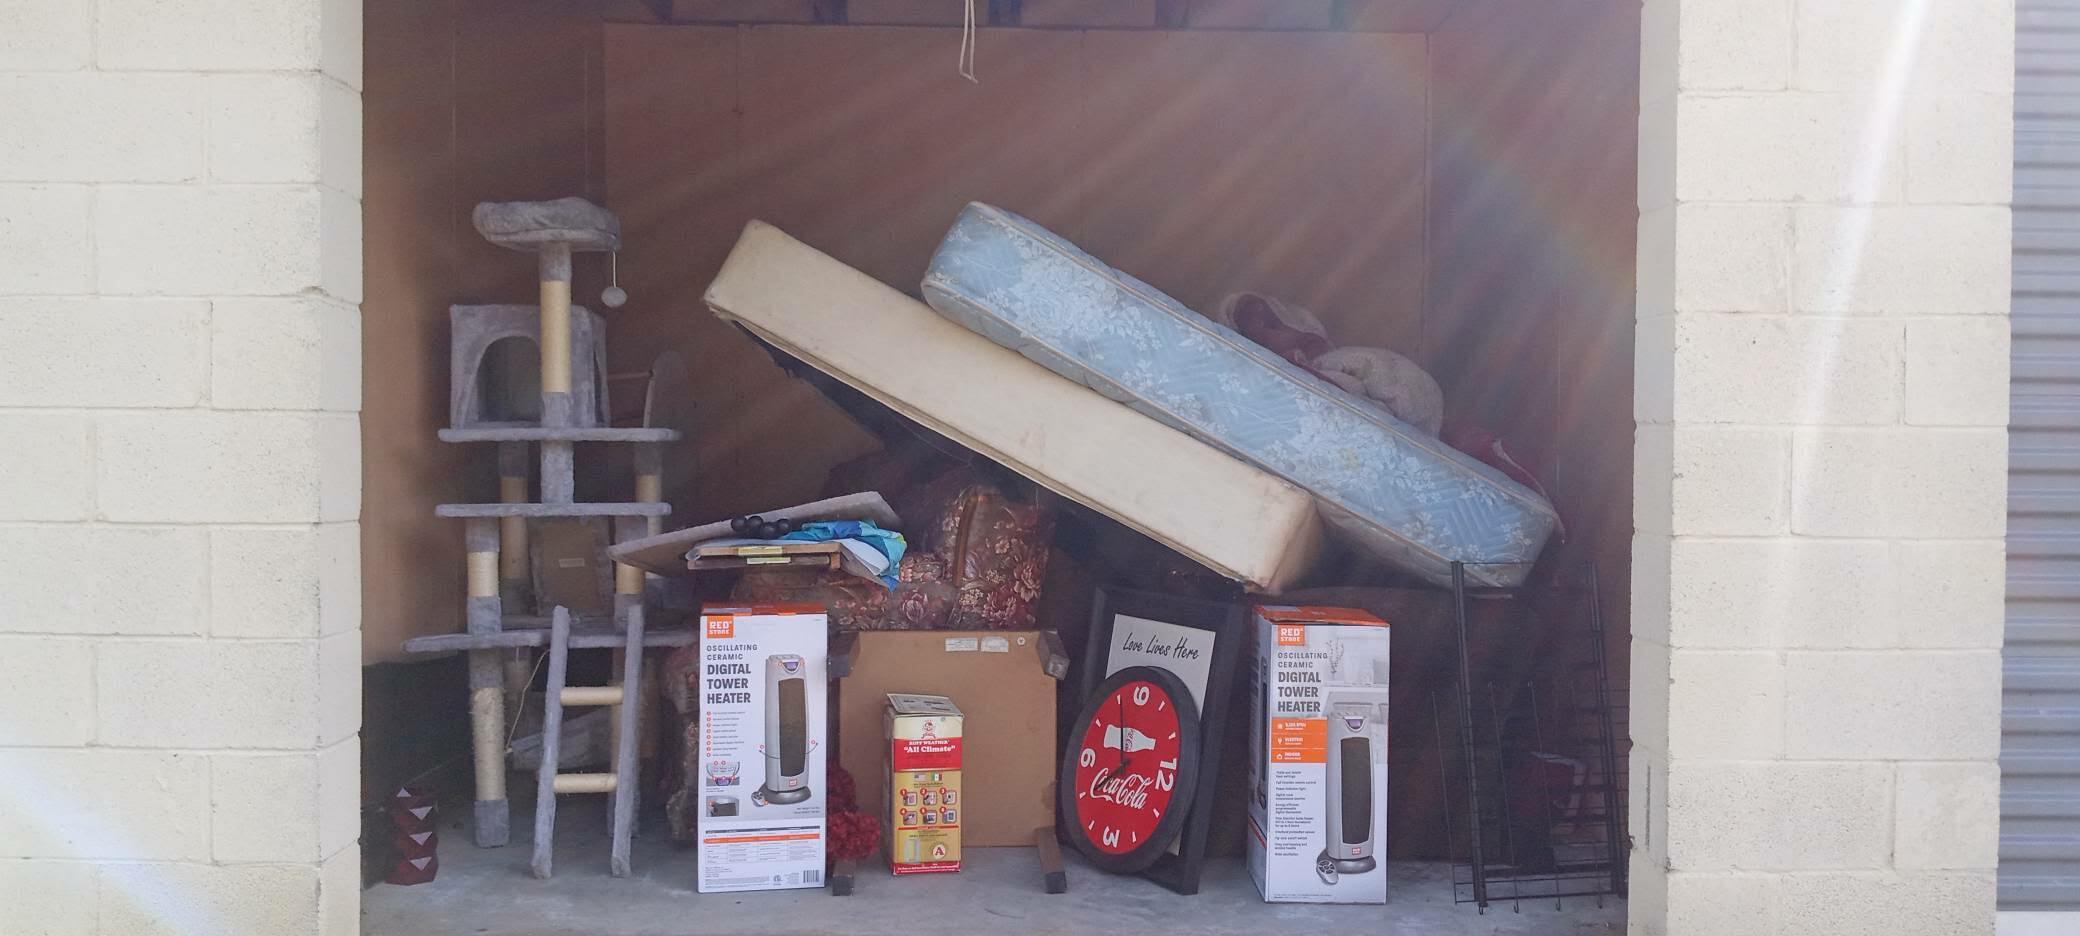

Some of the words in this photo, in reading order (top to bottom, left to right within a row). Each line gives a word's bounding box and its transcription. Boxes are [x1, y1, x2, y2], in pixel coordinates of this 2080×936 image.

[709, 621, 730, 630] RED
[1280, 628, 1300, 637] RED
[706, 644, 758, 652] OSCILLATING
[1122, 632, 1143, 652] Love
[1146, 634, 1171, 656] Lives
[1173, 636, 1199, 660] Here
[706, 653, 743, 661] CERAMIC
[707, 663, 752, 675] DIGITAL
[1278, 671, 1322, 683] DIGITAL
[706, 678, 749, 690] TOWER
[706, 692, 751, 704] HEATER
[1278, 686, 1319, 698] TOWER
[1277, 701, 1321, 713] HEATER
[1155, 758, 1178, 792] 12
[1102, 826, 1120, 848] 3
[935, 847, 945, 856] A
